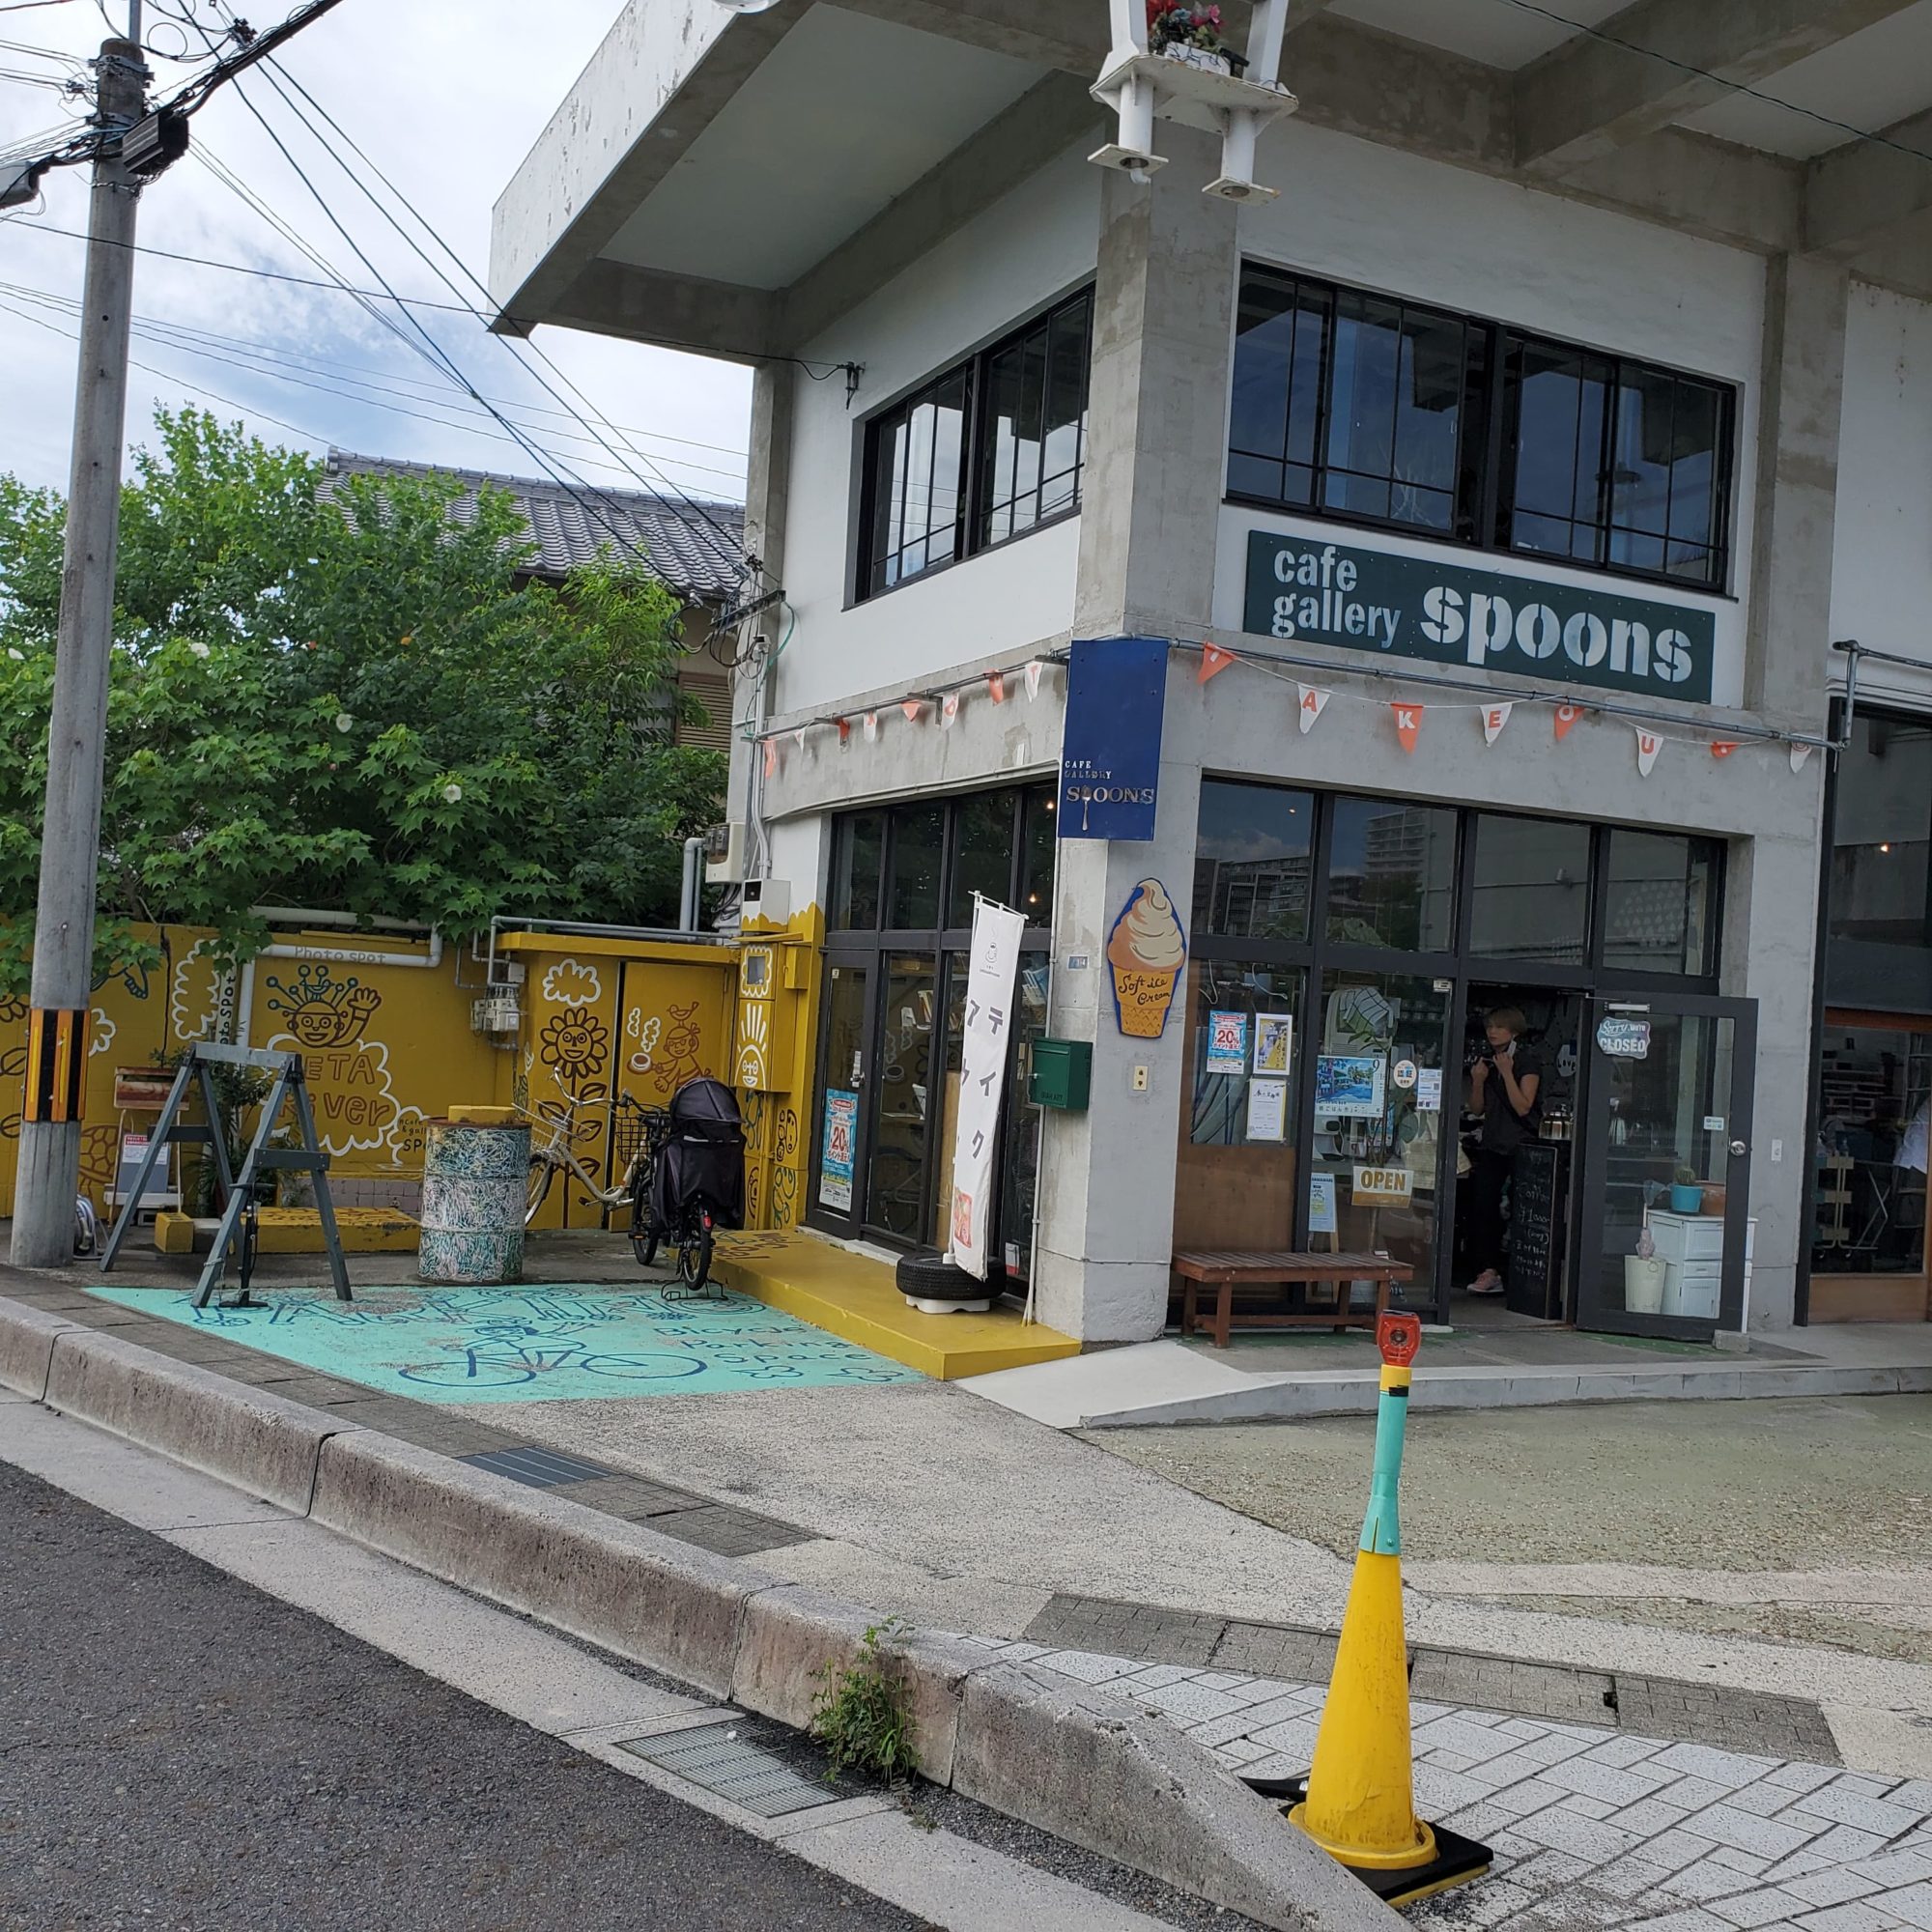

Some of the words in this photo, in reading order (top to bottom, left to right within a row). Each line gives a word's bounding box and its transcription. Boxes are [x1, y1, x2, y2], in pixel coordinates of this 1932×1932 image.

[1274, 546, 1358, 592] cafe
[1271, 589, 1402, 648] gallery
[1420, 585, 1692, 683] spoons
[1065, 760, 1092, 769] CAFE
[1065, 785, 1154, 805] SOONS
[294, 946, 344, 961] Photo
[1118, 974, 1146, 995] Soft
[219, 1021, 230, 1045] oto
[1600, 1037, 1646, 1053] CLOSED
[304, 1054, 375, 1085] ETA
[972, 1007, 1003, 1159] テイク
[1360, 1170, 1406, 1191] OPEN
[653, 1326, 808, 1336] Bicycle
[680, 1339, 853, 1350] Parking
[713, 1352, 871, 1364] Space
